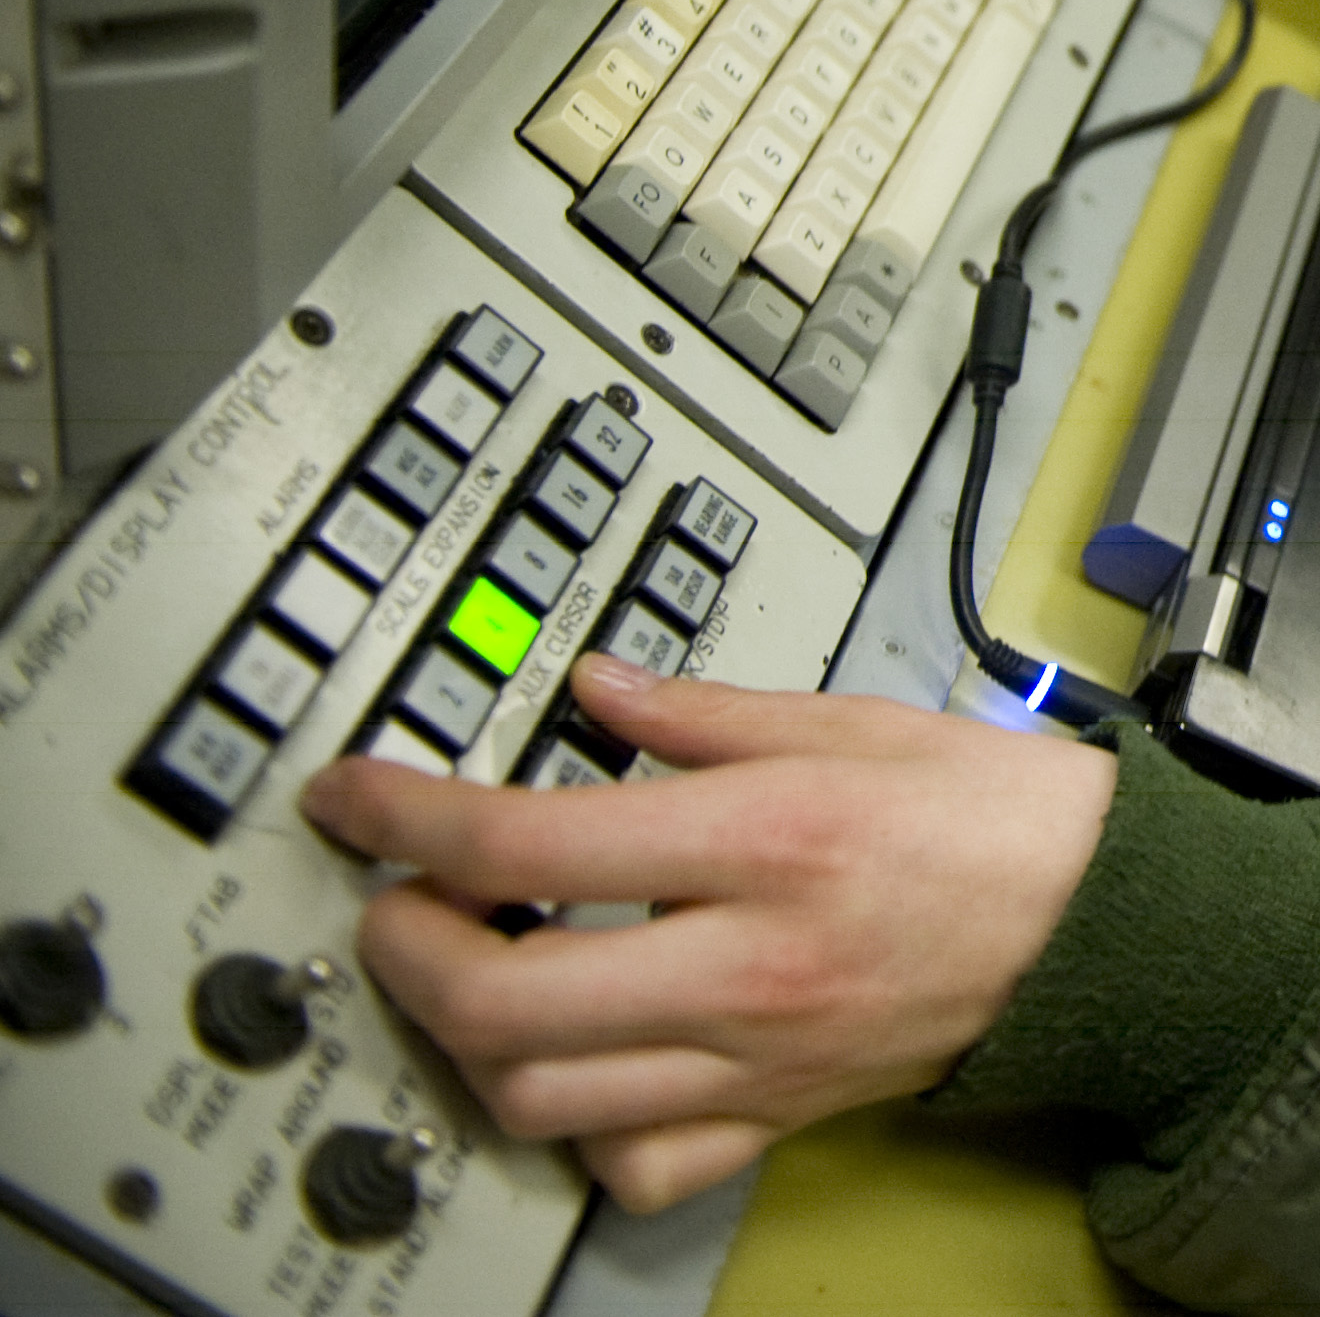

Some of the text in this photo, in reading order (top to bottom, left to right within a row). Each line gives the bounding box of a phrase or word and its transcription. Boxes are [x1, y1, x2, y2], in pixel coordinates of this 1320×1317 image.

[656, 36, 678, 57] 3
[722, 61, 744, 83] E
[625, 80, 648, 101] 2
[692, 100, 715, 123] W
[788, 104, 810, 126] D
[593, 123, 614, 139] 1
[762, 145, 784, 166] S
[854, 143, 875, 165] C
[736, 190, 755, 209] A
[830, 187, 851, 209] X
[803, 228, 825, 251] Z
[854, 308, 873, 327] A
[829, 353, 846, 376] P
[595, 424, 624, 454] 32
[254, 457, 321, 538] ALARMS
[560, 483, 589, 510] 16
[423, 463, 502, 568] EXPANSION
[691, 493, 725, 538] BEARING
[711, 510, 740, 546] RANGE
[0, 363, 290, 718] LARMS/DISPLAY CONTROL
[675, 568, 707, 610] CURSOR
[516, 580, 600, 706] AUX CURSOR
[437, 684, 464, 708] 2
[281, 1037, 348, 1145] AROUND
